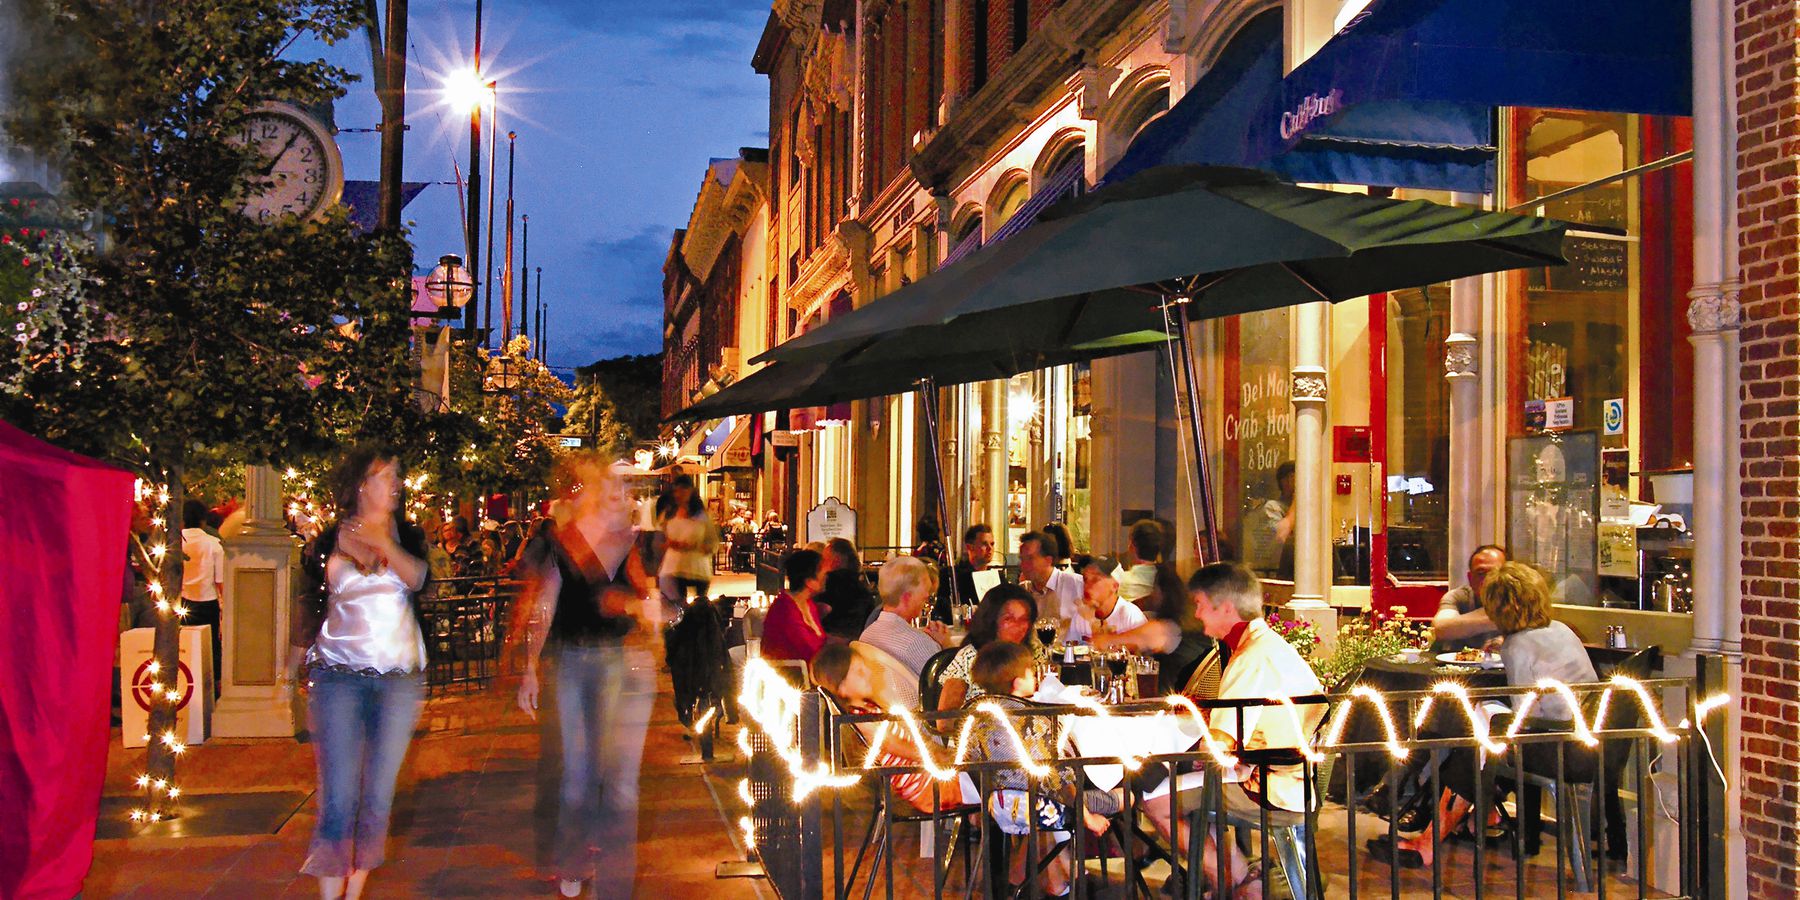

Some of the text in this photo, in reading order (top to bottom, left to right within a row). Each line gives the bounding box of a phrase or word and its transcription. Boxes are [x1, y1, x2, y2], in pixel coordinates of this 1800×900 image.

[262, 124, 278, 139] 12
[300, 147, 312, 162] 2
[304, 168, 317, 184] 3
[295, 191, 308, 205] 4
[1243, 375, 1263, 408] Del
[1225, 409, 1259, 441] Crab
[1256, 441, 1280, 470] Bar
